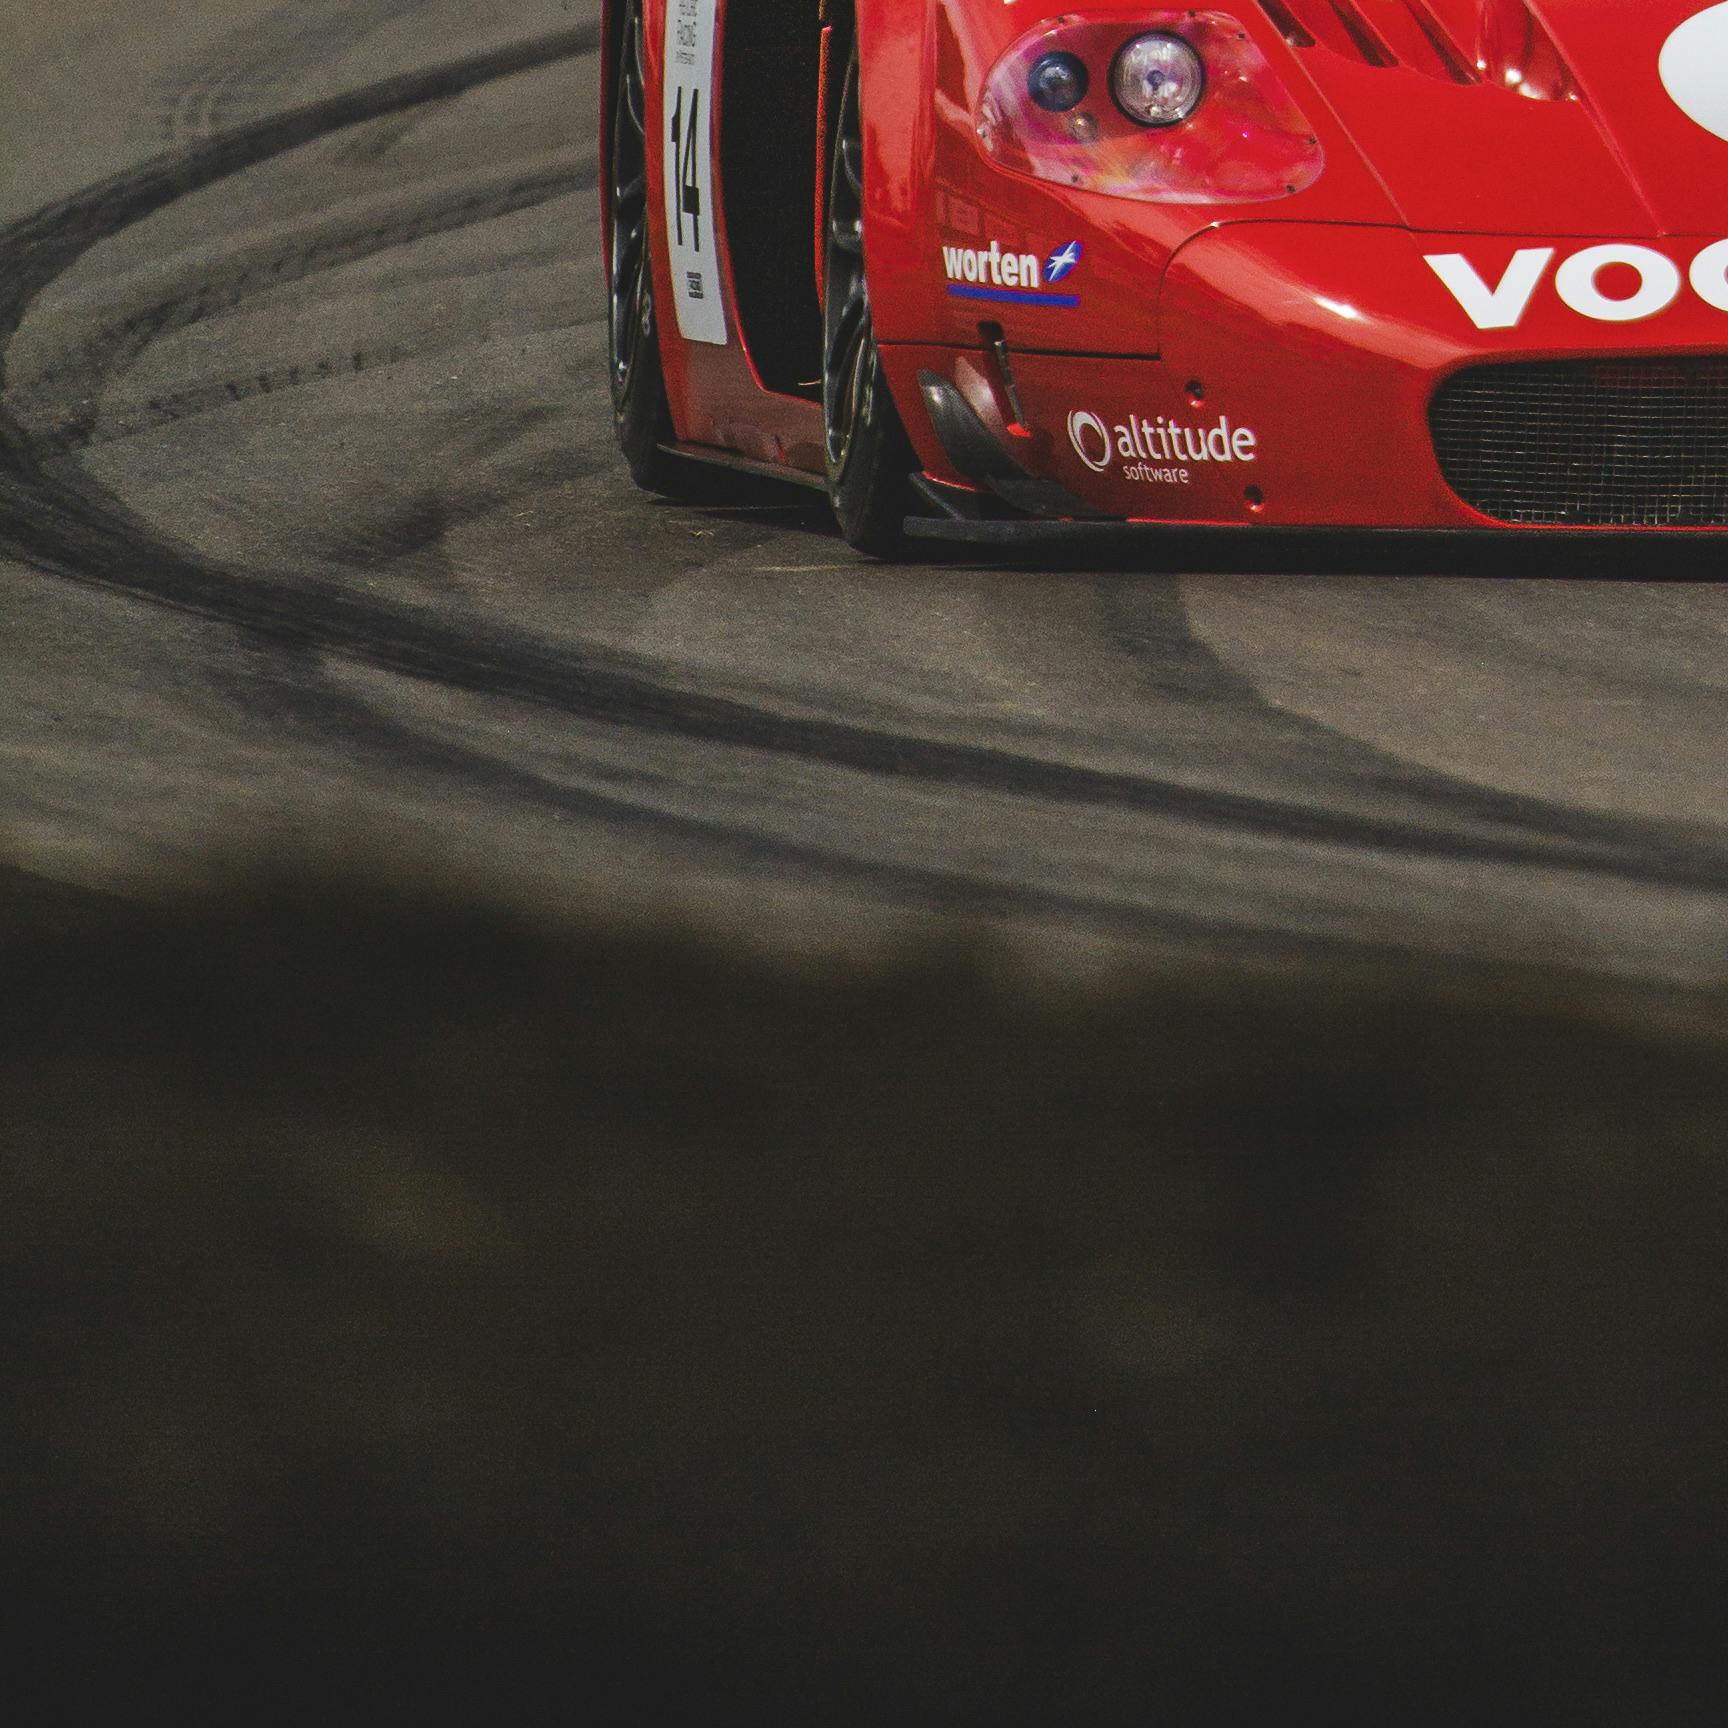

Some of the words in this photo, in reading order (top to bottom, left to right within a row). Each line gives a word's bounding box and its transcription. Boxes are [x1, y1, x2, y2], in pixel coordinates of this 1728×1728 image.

[942, 240, 1039, 288] worten
[1113, 414, 1257, 463] altitude
[1122, 461, 1189, 484] software
